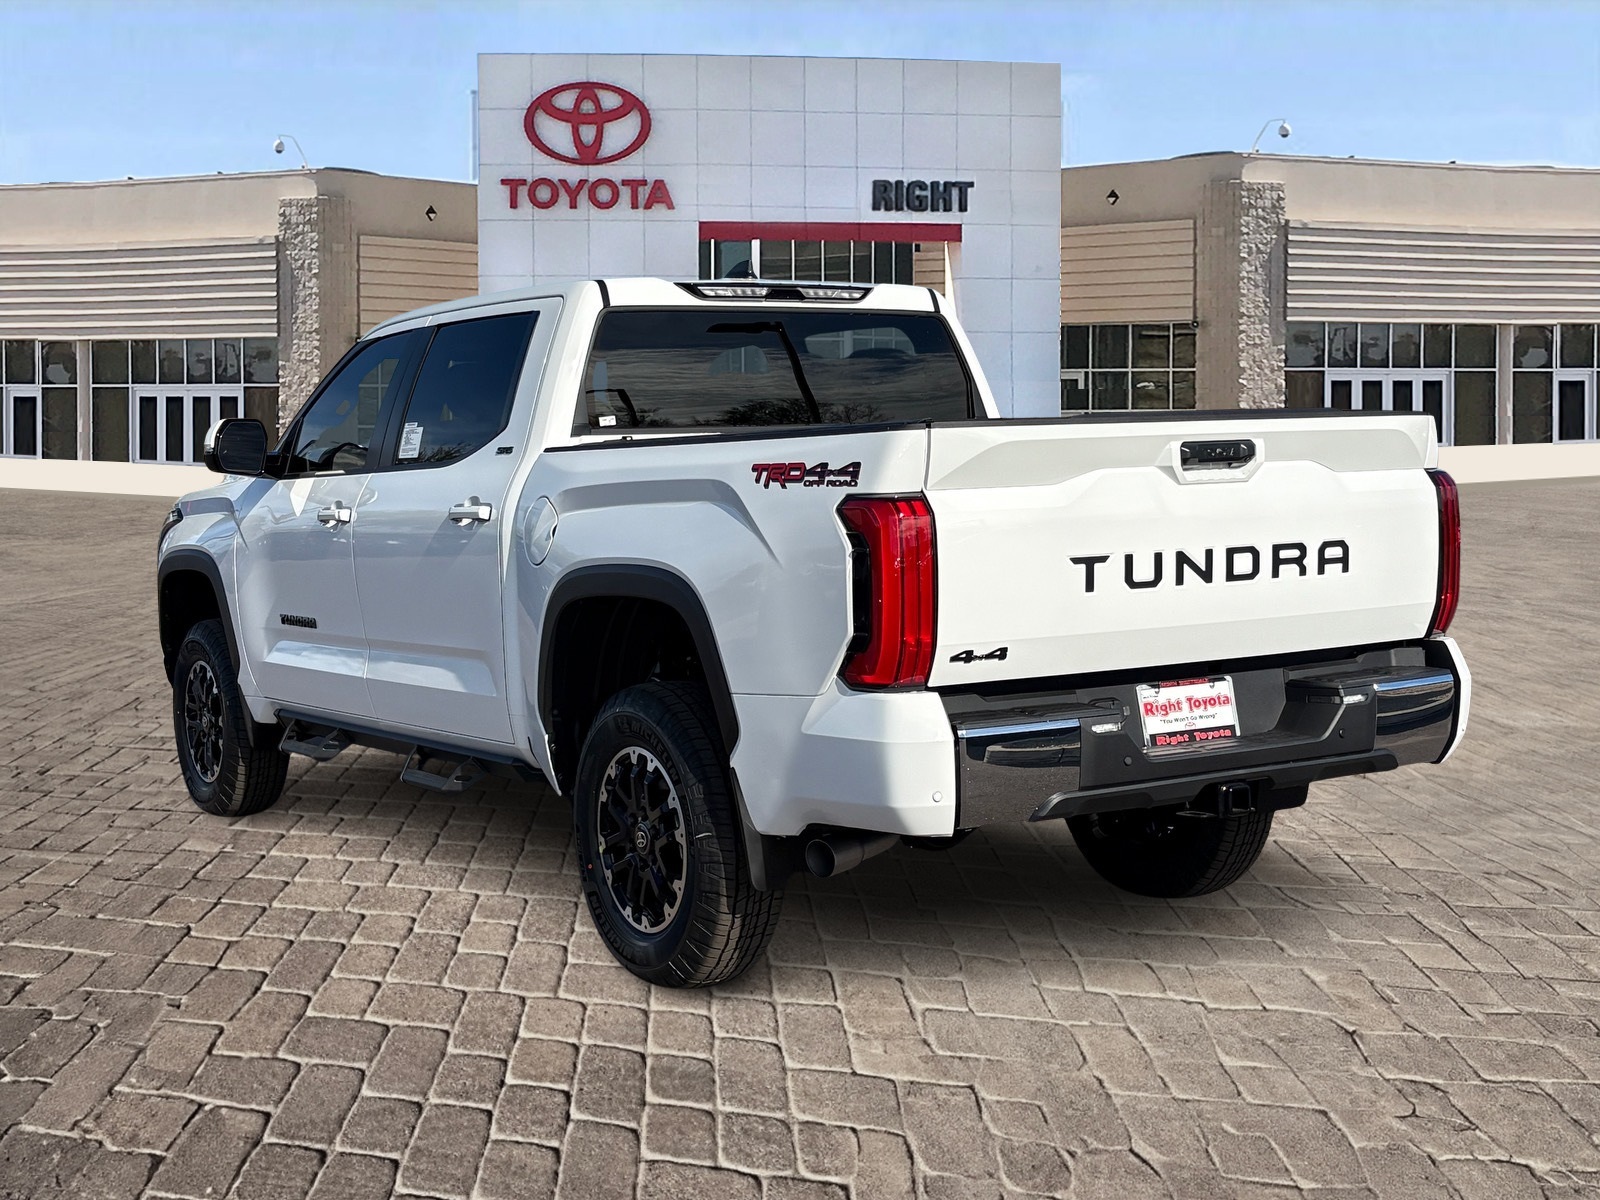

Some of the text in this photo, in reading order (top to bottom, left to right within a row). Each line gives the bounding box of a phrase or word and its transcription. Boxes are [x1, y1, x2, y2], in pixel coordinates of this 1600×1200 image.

[500, 177, 675, 210] TOYOTA
[872, 179, 975, 213] RIGHT
[752, 462, 806, 489] TRD
[803, 479, 858, 487] OFF ROAD
[1069, 539, 1349, 593] TUNDRA
[1143, 695, 1230, 717] Right Toyota
[1156, 728, 1232, 746] Right Toyota
